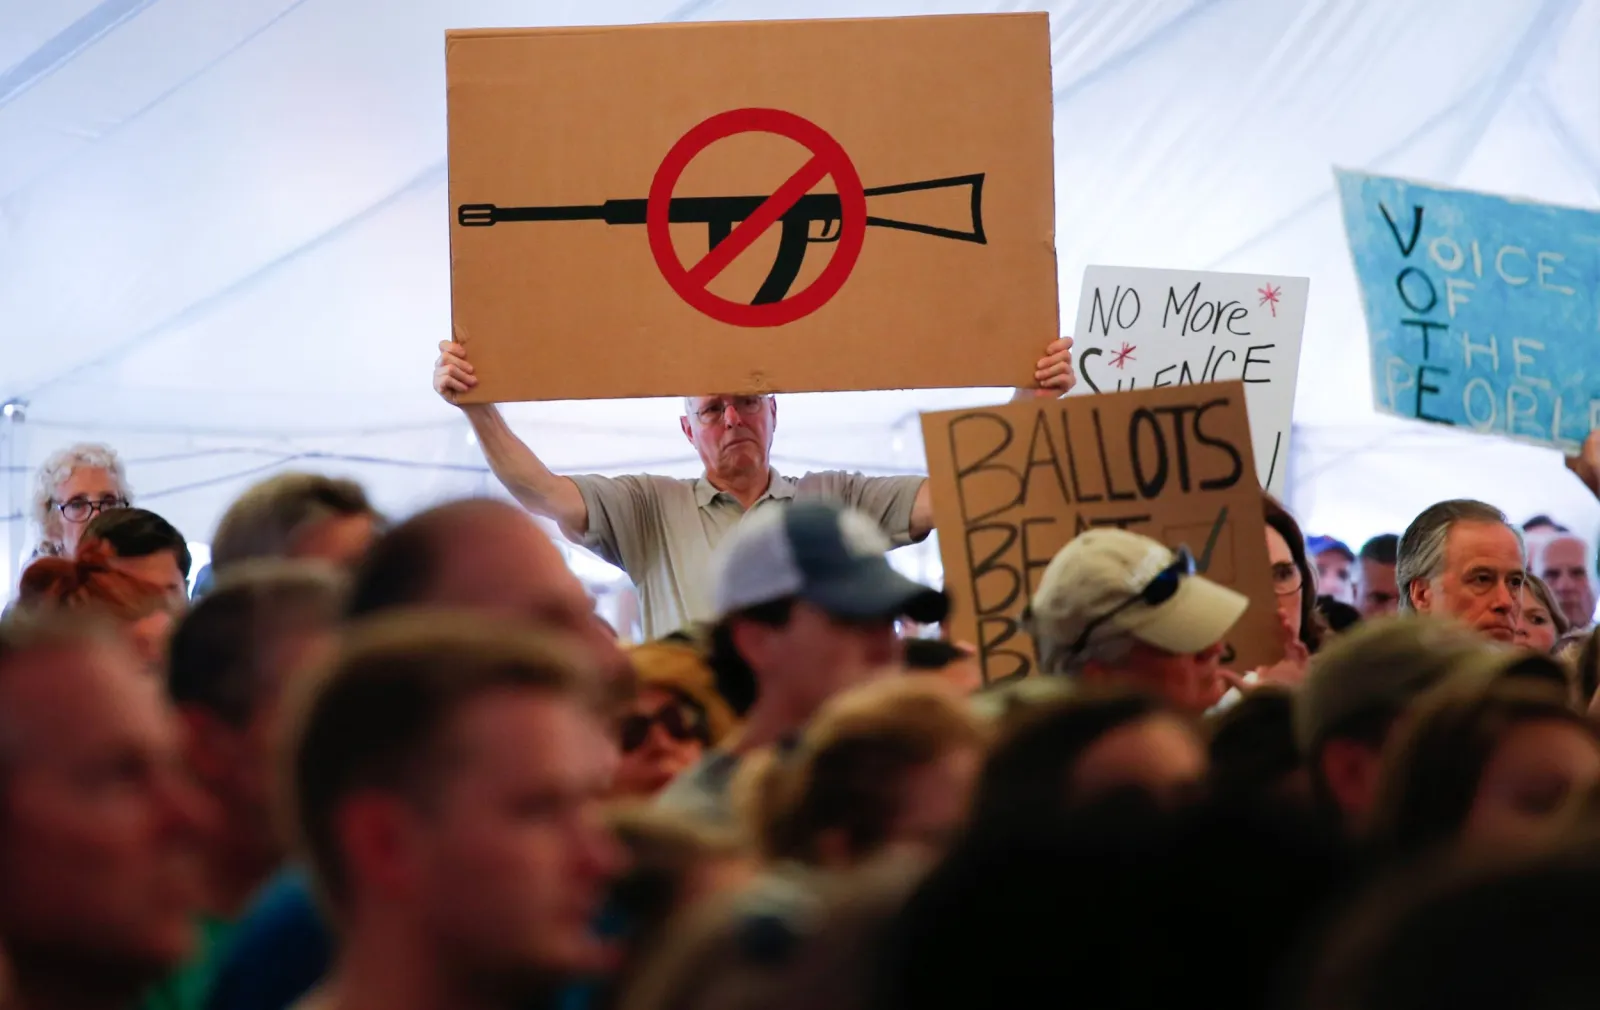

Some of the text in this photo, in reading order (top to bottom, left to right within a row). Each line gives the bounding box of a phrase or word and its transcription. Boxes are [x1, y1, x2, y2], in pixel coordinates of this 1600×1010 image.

[1088, 282, 1251, 337] NO More
[1079, 344, 1275, 394] SENCE
[948, 399, 1243, 525] BALLOTS
